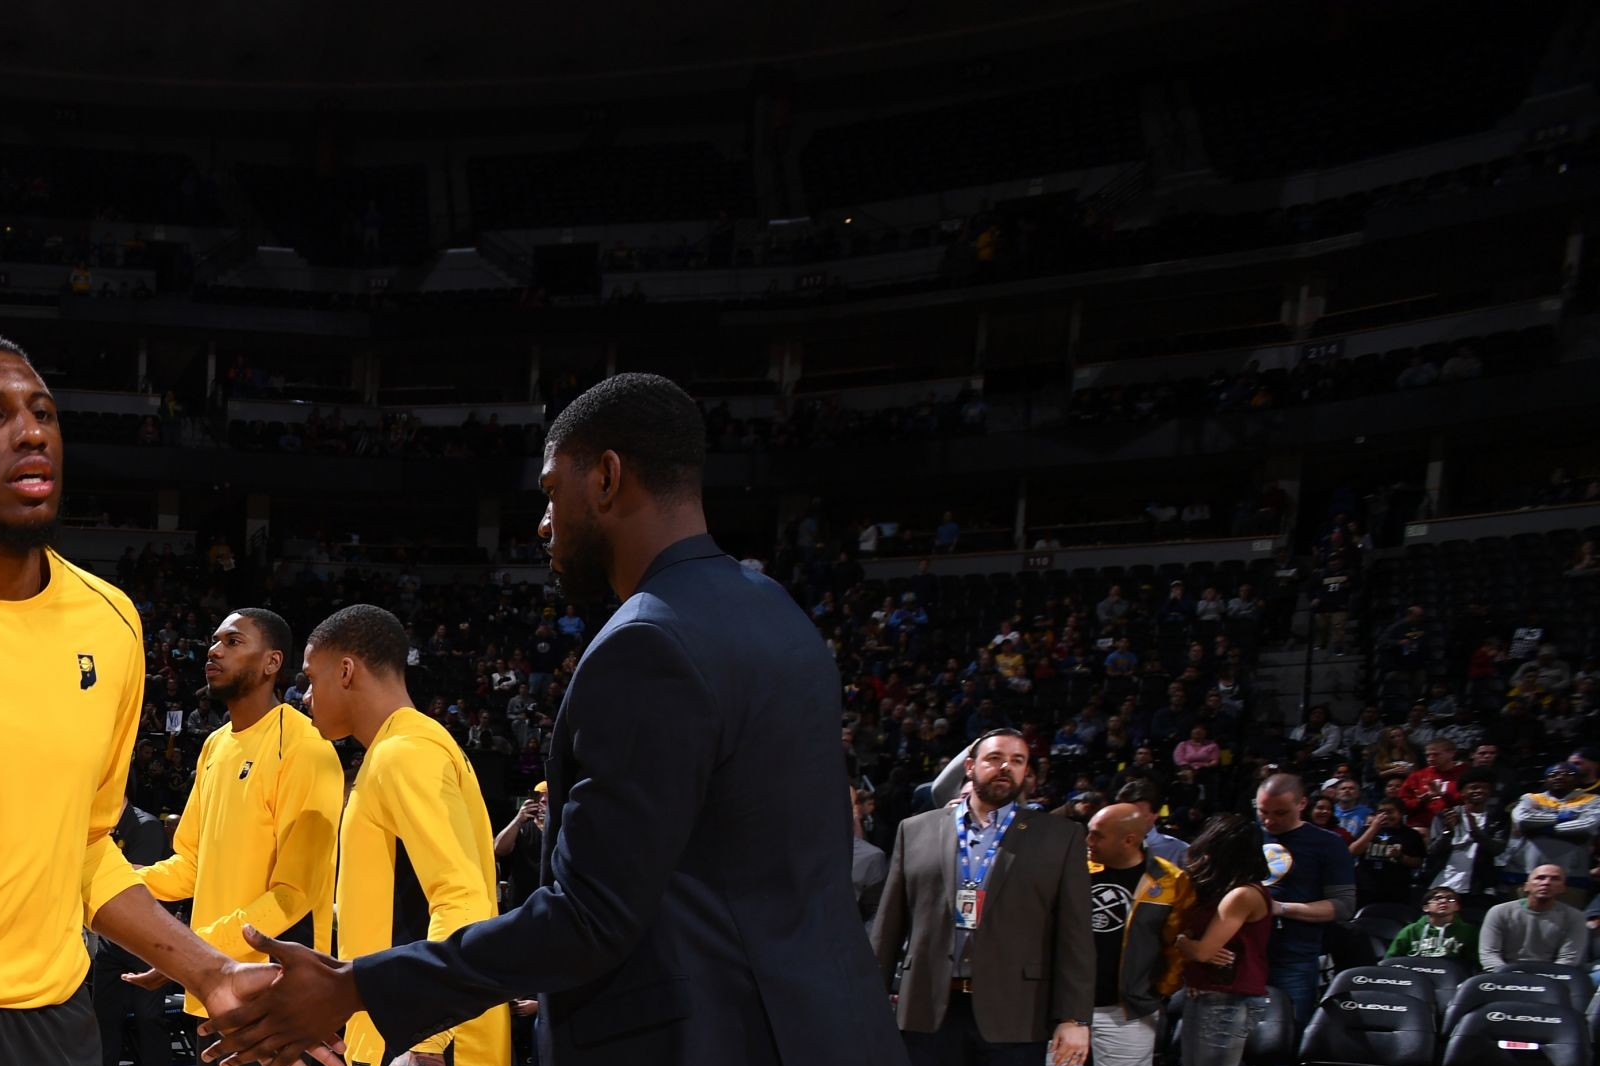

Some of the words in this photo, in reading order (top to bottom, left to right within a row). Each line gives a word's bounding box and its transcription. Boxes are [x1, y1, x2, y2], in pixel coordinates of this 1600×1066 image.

[1368, 978, 1413, 986] LEXUS
[1496, 984, 1547, 993] LEXUS
[1358, 1002, 1409, 1012] LEXUS
[1506, 1014, 1563, 1024] LEXUS
